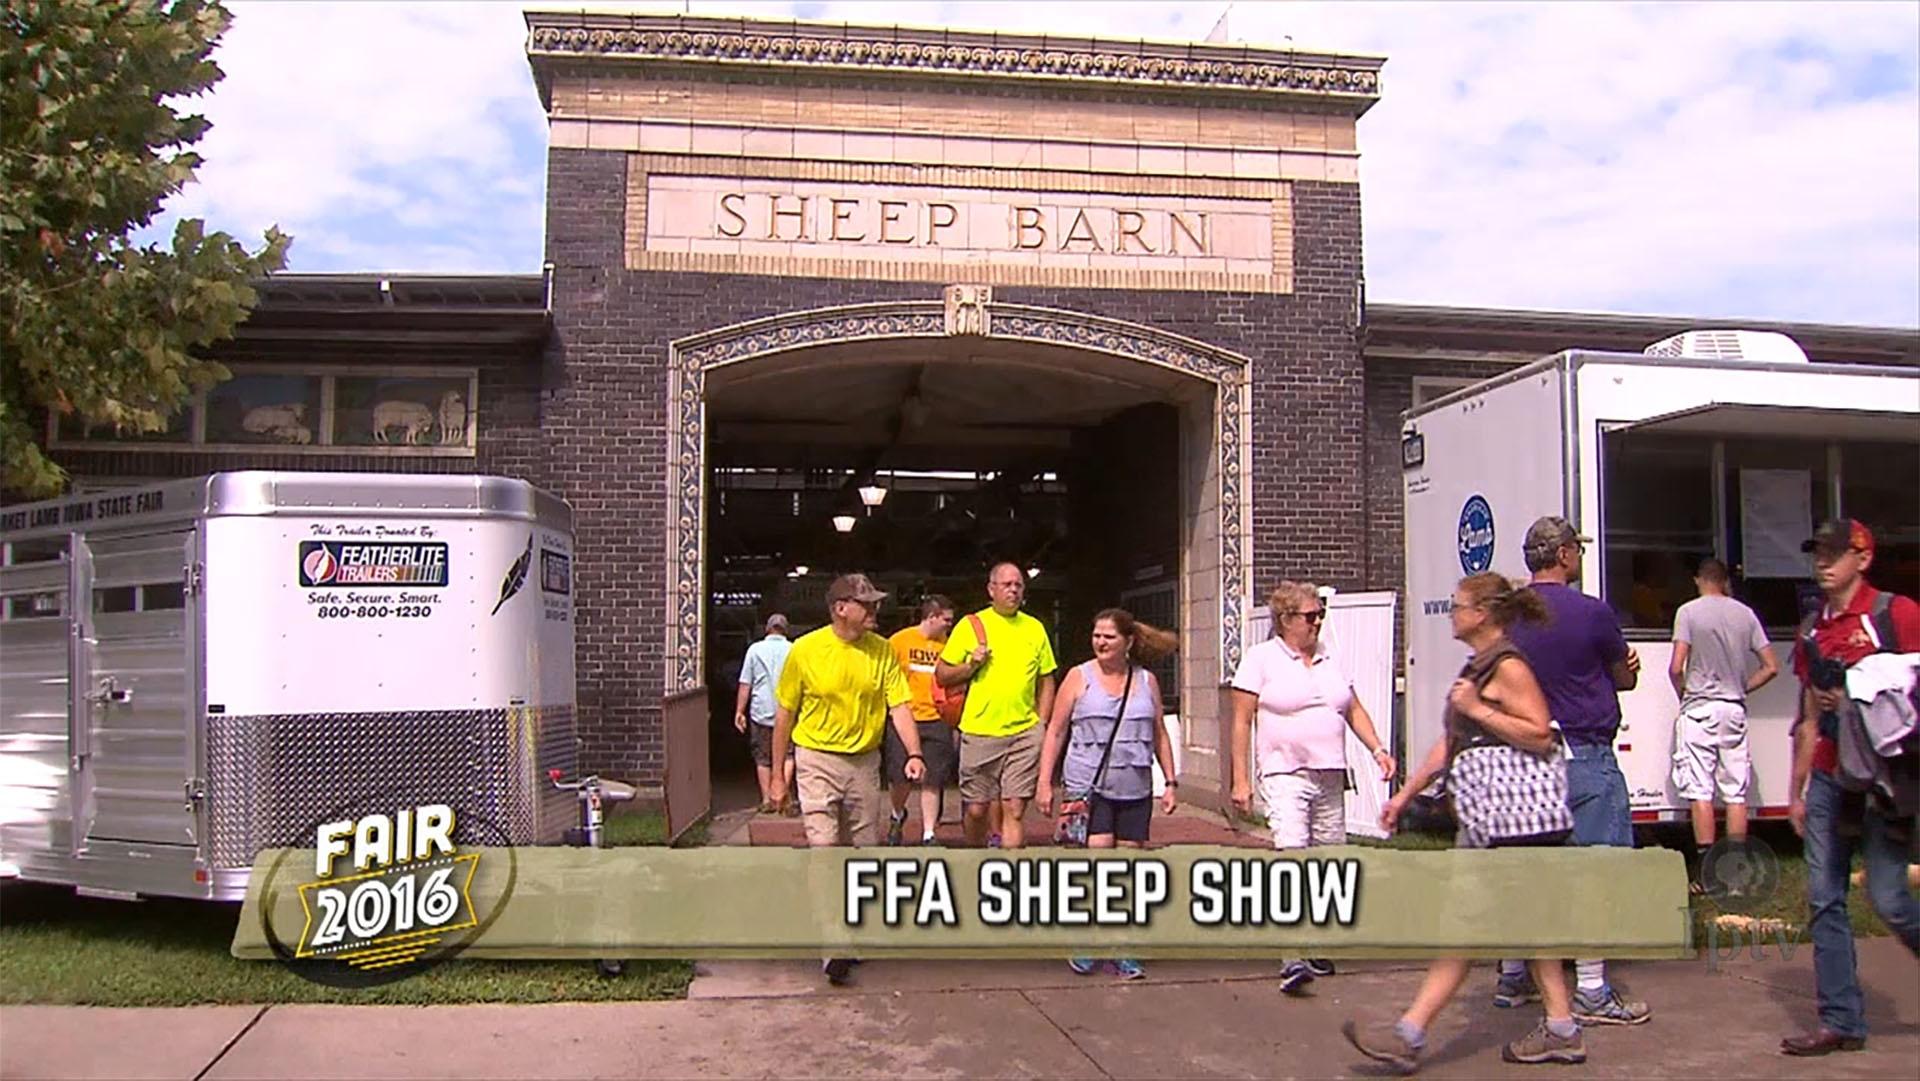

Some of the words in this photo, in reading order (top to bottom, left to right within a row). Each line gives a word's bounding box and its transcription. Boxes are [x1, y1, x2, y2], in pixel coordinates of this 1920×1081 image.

[716, 193, 959, 245] SHEEP
[1012, 205, 1208, 256] BARN
[30, 506, 59, 528] LAMB
[64, 501, 93, 524] IOWA
[97, 495, 132, 519] STATE
[136, 490, 164, 514] FAIR
[310, 524, 333, 536] This
[336, 524, 371, 536] Trailer
[375, 525, 417, 538] Donated
[1459, 521, 1493, 553] Lamb
[340, 546, 446, 566] FEATHERLITE
[340, 566, 399, 582] TRAILERS
[307, 592, 342, 604] Safe.
[346, 592, 395, 604] Secure.
[398, 592, 442, 604] Smart.
[317, 605, 432, 619] 800-800-1230
[909, 648, 940, 661] IOW
